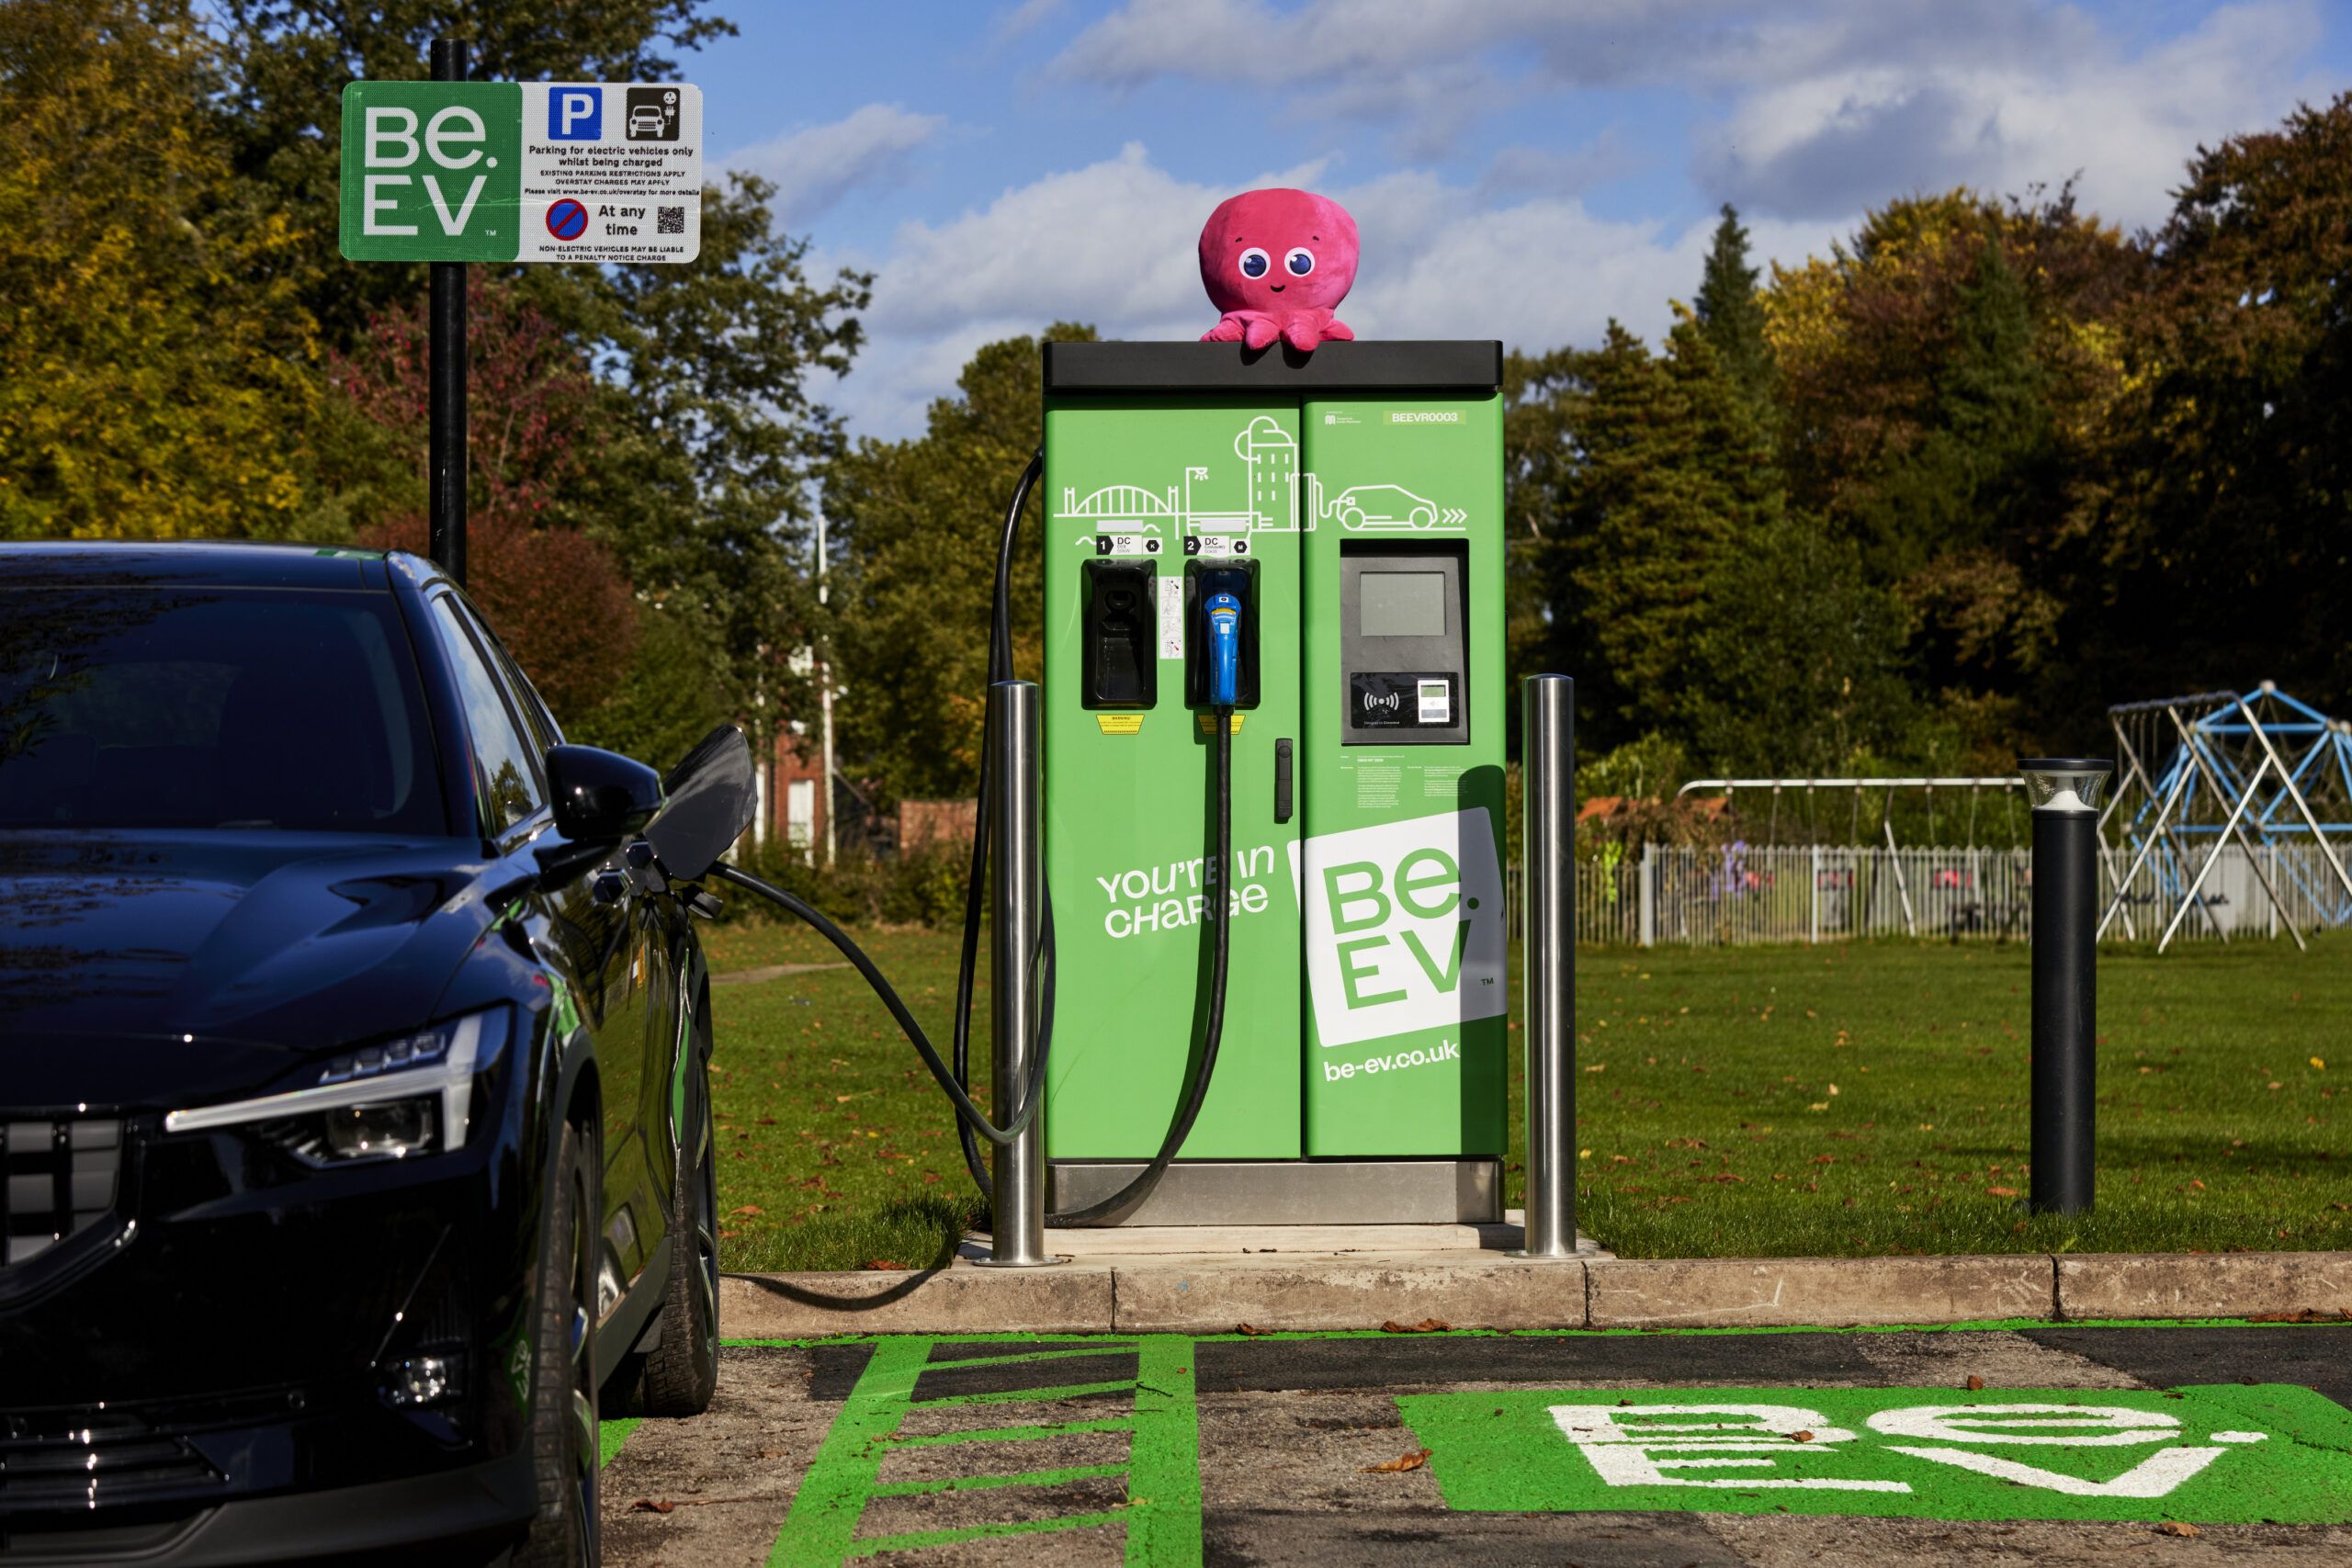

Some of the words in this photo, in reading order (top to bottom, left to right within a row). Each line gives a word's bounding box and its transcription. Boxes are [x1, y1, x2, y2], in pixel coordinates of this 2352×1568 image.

[561, 94, 594, 135] P
[364, 106, 498, 170] Be.
[529, 145, 567, 156] Parking
[570, 145, 584, 155] for
[587, 145, 626, 155] electric
[628, 146, 669, 156] vehicles
[672, 147, 694, 157] only
[559, 157, 589, 166] whilst
[592, 158, 619, 168] being
[622, 158, 662, 168] charged
[363, 175, 488, 236] EV
[598, 205, 616, 217] At
[620, 207, 646, 220] any
[605, 223, 638, 236] time
[1100, 540, 1106, 550] 1
[1187, 541, 1194, 550] 2
[1204, 537, 1218, 546] DC
[1323, 848, 1479, 935] Be.
[1337, 919, 1472, 1010] EV
[1324, 1040, 1460, 1082] be-ev.co.uk
